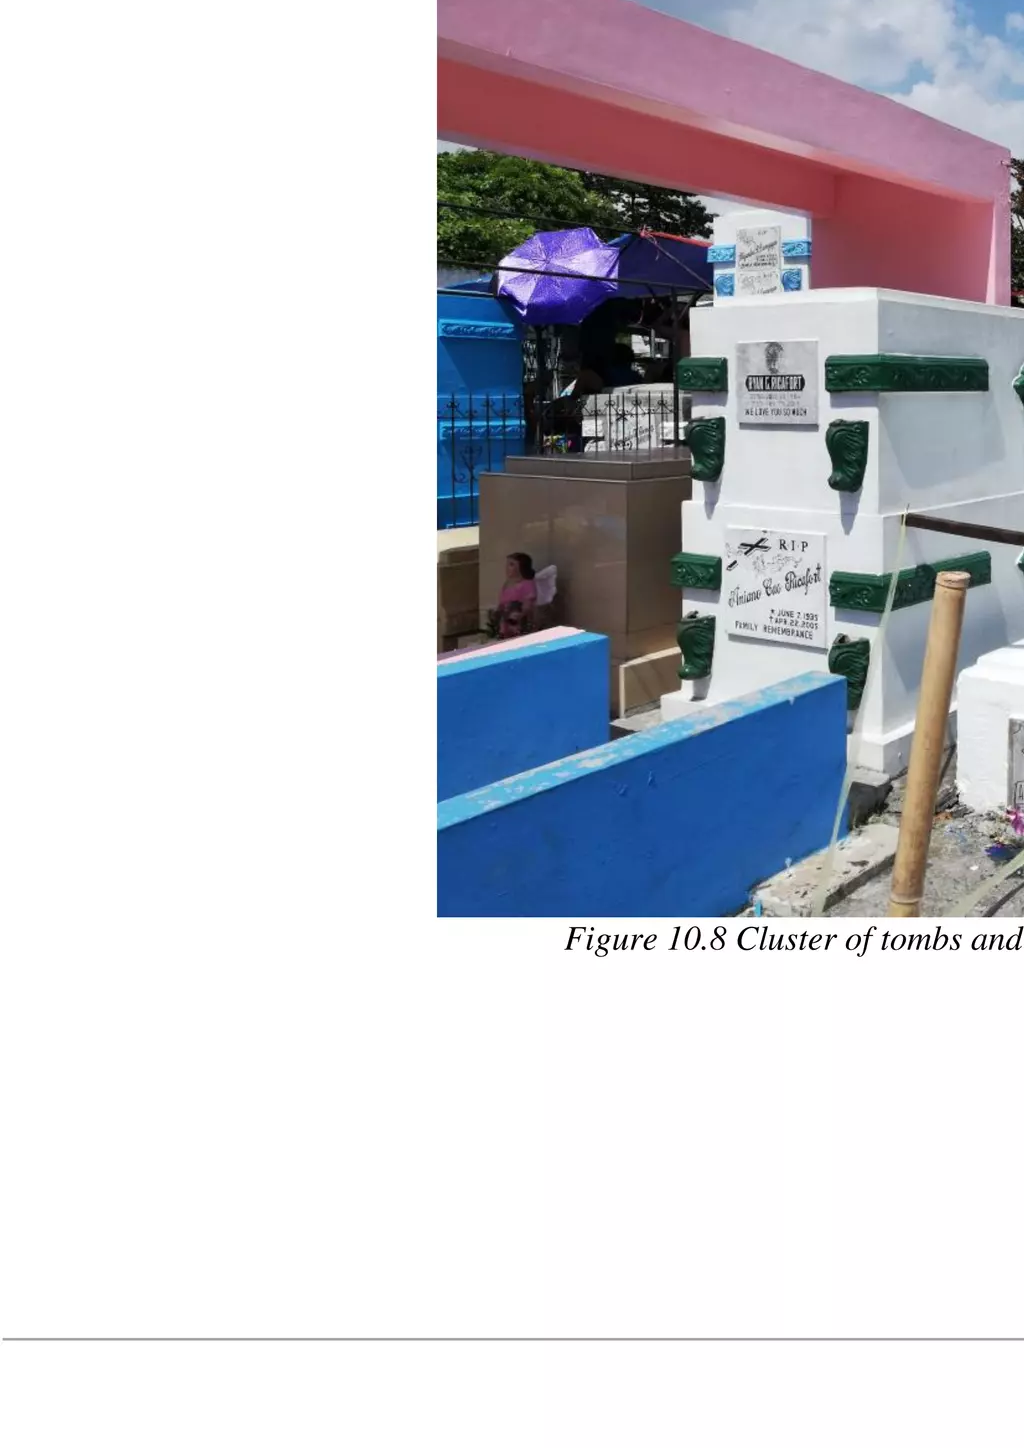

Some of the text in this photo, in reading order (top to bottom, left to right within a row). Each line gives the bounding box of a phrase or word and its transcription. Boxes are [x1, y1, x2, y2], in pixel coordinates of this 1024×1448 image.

[735, 620, 758, 632] FAMILY
[763, 624, 813, 641] REMEMBRANCE
[565, 926, 658, 958] Figure
[669, 926, 727, 951] 10.8
[738, 926, 838, 951] Cluster
[846, 926, 878, 958] of
[881, 926, 963, 951] tombs
[972, 926, 1024, 951] and
